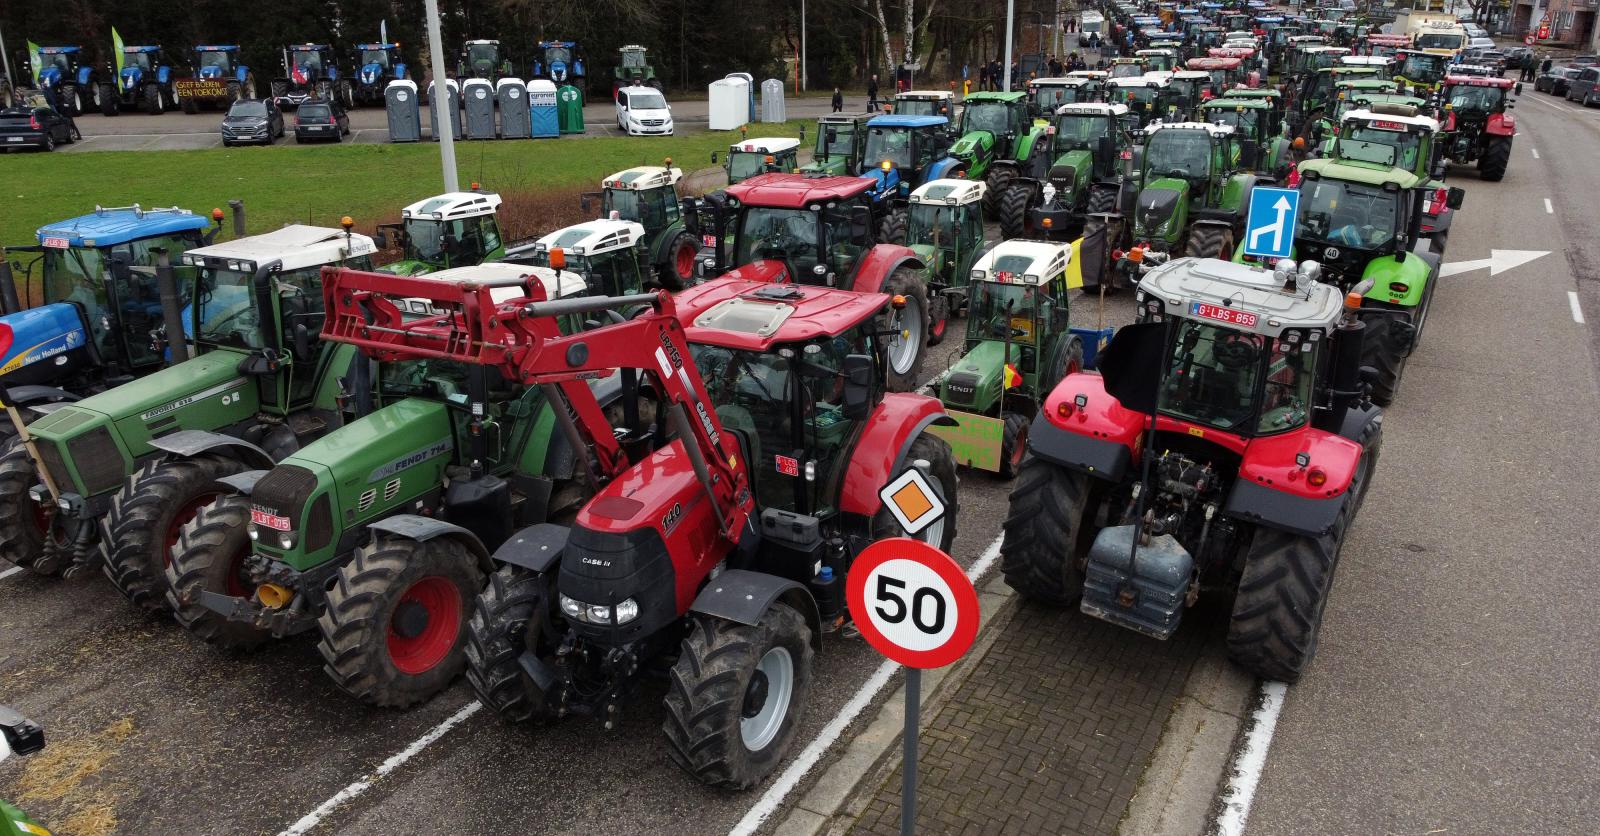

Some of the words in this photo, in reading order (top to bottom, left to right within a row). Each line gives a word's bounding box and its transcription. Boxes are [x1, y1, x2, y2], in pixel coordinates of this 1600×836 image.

[178, 89, 193, 97] EEN
[1327, 248, 1337, 258] 40
[25, 354, 41, 365] New
[41, 343, 67, 358] Holland
[948, 384, 974, 393] FENDT
[145, 403, 177, 419] FAVORIT
[395, 450, 428, 471] FENDT
[430, 442, 446, 456] 714
[252, 503, 278, 515] FENDT
[661, 502, 681, 530] 140
[582, 557, 602, 566] CASE
[875, 574, 946, 635] 50
